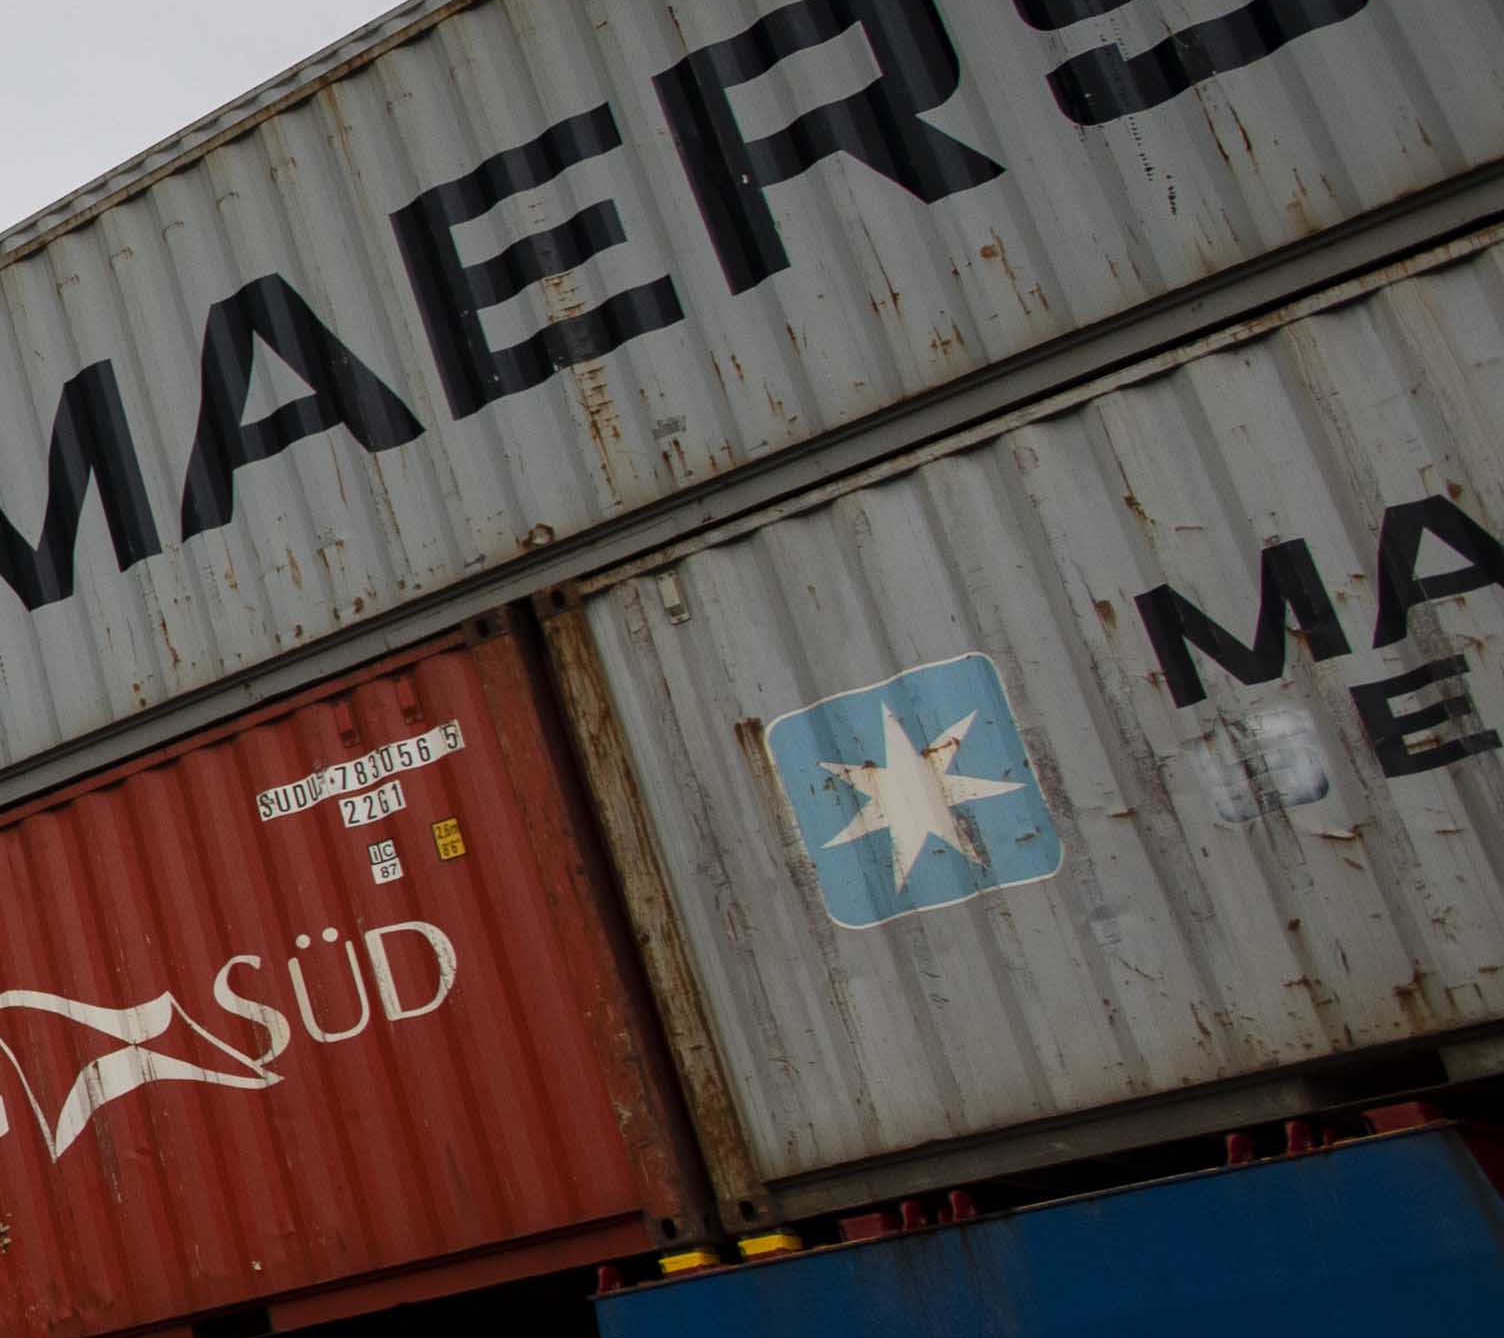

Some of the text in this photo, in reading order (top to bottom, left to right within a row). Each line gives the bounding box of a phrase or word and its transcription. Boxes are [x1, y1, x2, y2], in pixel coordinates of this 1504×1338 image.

[259, 724, 459, 818] SUDU 783056 5
[343, 783, 403, 824] 22G1
[213, 920, 457, 1063] SÜD
